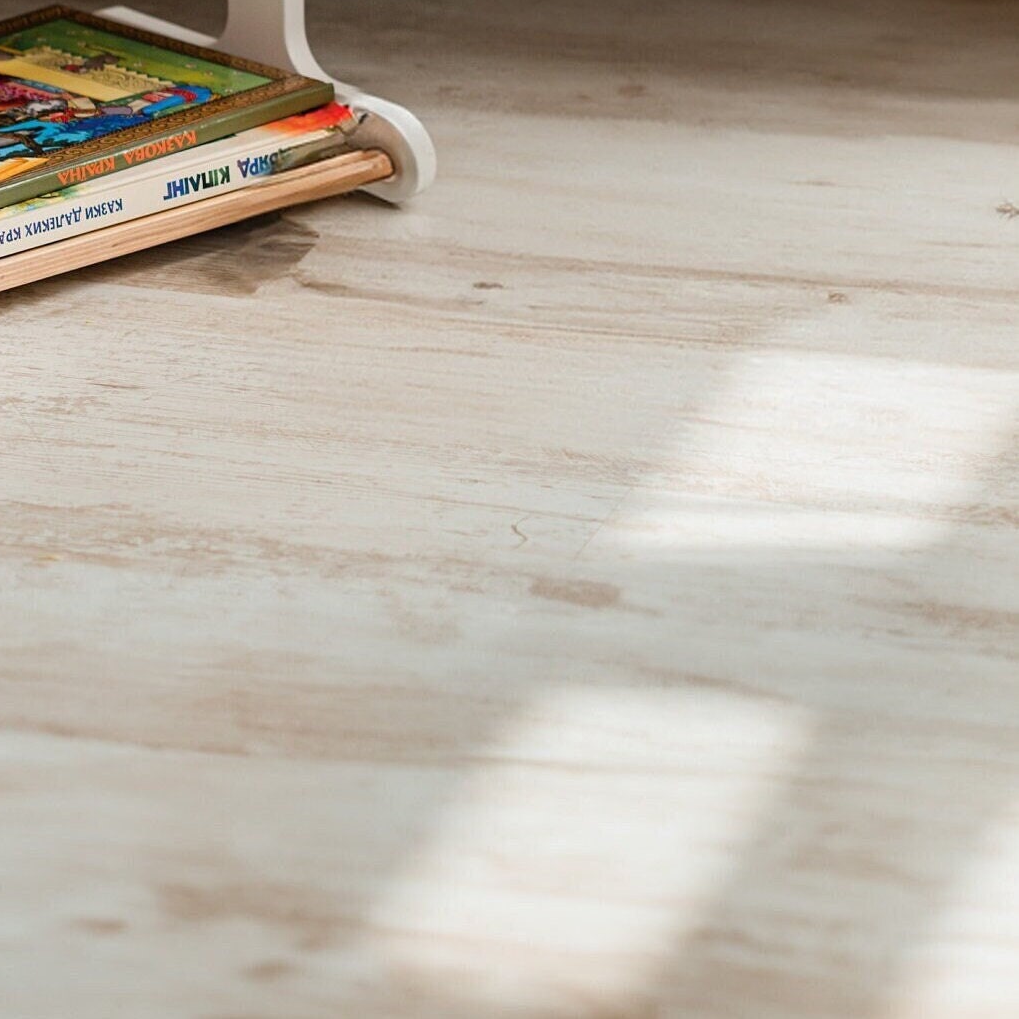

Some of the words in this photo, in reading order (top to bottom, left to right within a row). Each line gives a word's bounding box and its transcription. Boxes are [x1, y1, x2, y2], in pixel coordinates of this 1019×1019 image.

[123, 129, 198, 164] КАЗКОВА
[57, 155, 116, 186] КРАЇНА
[163, 165, 231, 201] КІПЛІНГ
[25, 206, 82, 237] ДАЛЕКИХ
[85, 198, 123, 220] КАЗКИ
